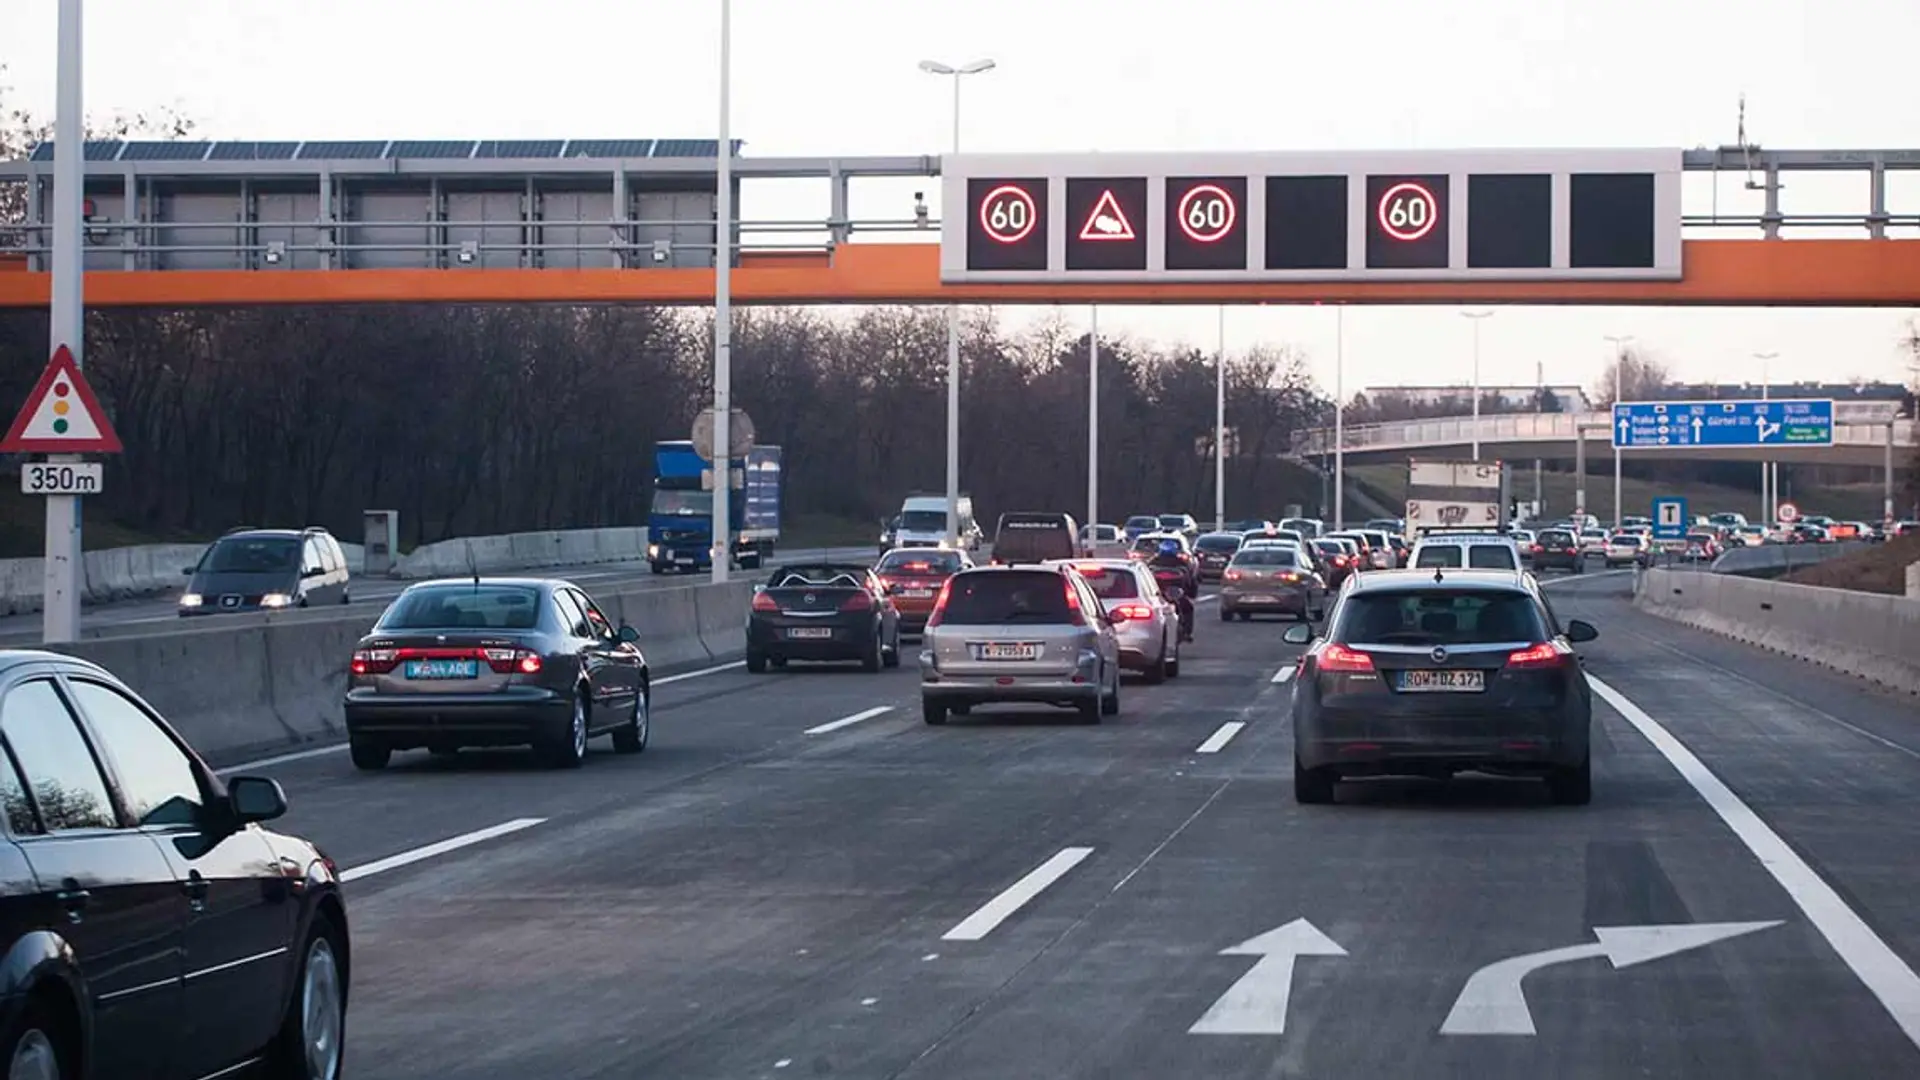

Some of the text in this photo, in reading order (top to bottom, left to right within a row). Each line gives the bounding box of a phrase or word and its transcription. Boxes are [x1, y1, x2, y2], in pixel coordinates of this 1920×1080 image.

[990, 200, 1026, 229] 60
[1188, 199, 1225, 229] 60
[1389, 197, 1426, 227] 60
[1664, 505, 1676, 522] T
[1406, 672, 1431, 686] ROW
[1459, 672, 1484, 686] 171
